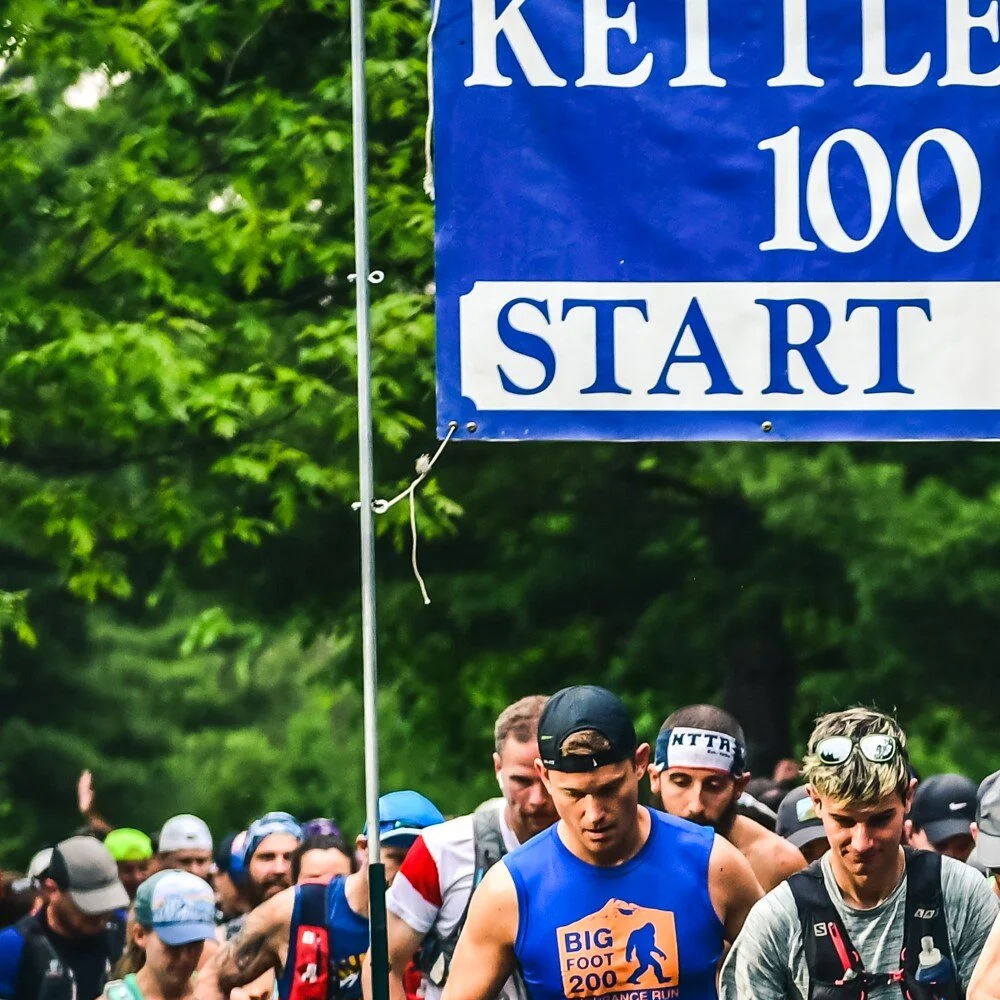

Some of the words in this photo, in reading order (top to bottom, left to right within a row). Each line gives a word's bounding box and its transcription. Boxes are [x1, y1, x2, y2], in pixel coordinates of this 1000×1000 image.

[758, 126, 982, 253] 100
[496, 296, 932, 395] START
[565, 928, 614, 953] BIG
[567, 953, 614, 971] FOOT
[569, 970, 617, 993] 200
